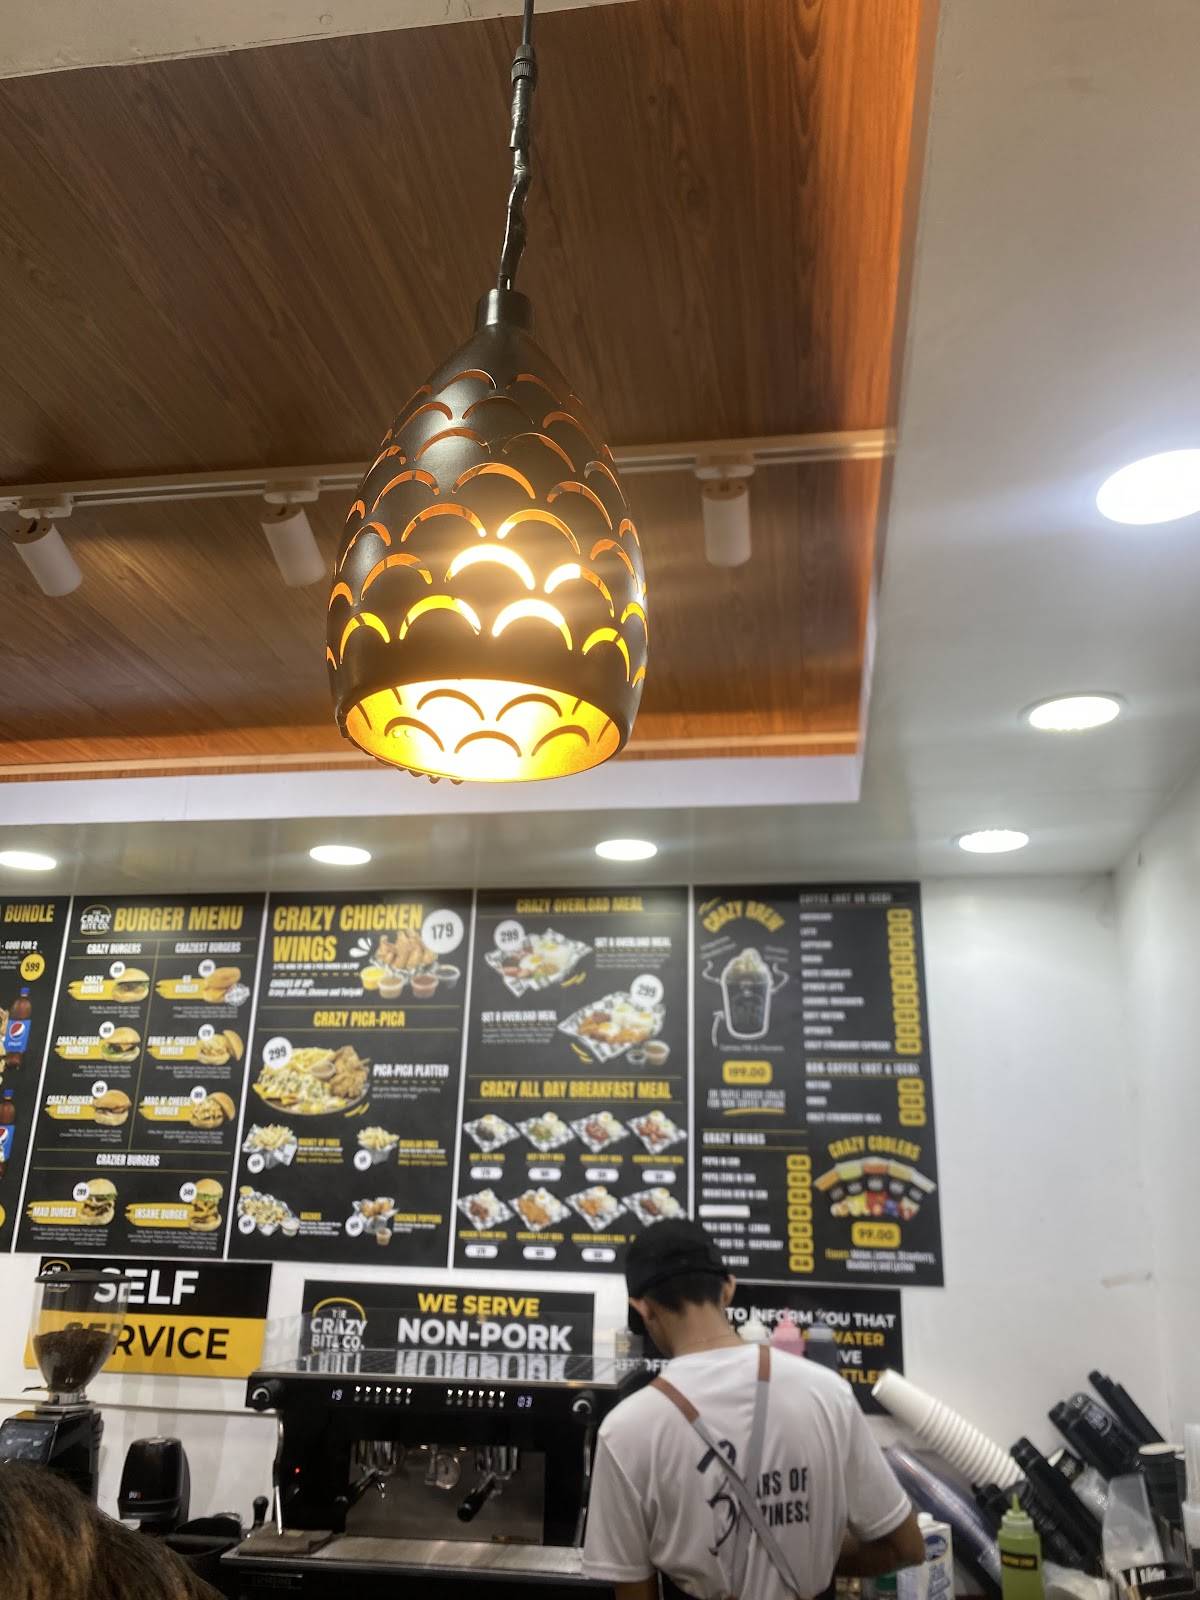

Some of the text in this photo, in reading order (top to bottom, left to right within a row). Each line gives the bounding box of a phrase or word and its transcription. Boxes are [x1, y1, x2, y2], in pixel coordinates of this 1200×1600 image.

[516, 897, 644, 913] CRAZY OVERLOAD MEAL
[4, 904, 55, 923] BUNDLE
[81, 914, 112, 924] CRAZY
[113, 905, 244, 932] BURGER MENU
[273, 904, 423, 931] CRAZY CHICKEN
[702, 901, 742, 933] CRAZY
[81, 923, 97, 931] BITE
[431, 923, 454, 940] 179
[86, 943, 142, 955] CRAZY BURGERS
[175, 942, 241, 953] CRAZIEST BURGERS
[273, 936, 338, 962] WINGS
[25, 963, 40, 973] 599
[313, 1011, 406, 1027] CRAZY PICA-PICA
[267, 1046, 287, 1061] 299
[373, 1064, 449, 1078] PICA-PICA PLATTER
[728, 1066, 766, 1078] 199.00
[480, 1080, 672, 1099] CRAZY ALL DAY BREAKFAST MEAL
[703, 1132, 731, 1144] CRAZY
[828, 1135, 922, 1162] CRAZY COOLERS
[96, 1154, 160, 1167] CRAZIER BURGERS
[50, 1207, 77, 1217] BURGER
[160, 1209, 188, 1220] BURGER
[858, 1228, 895, 1240] 99.00
[94, 1267, 199, 1305] SELF
[418, 1293, 540, 1318] WE SERVE
[726, 1307, 747, 1320] TO
[853, 1312, 896, 1328] THAT
[311, 1318, 367, 1336] CRAZY
[398, 1317, 573, 1351] NON-PORK
[342, 1335, 365, 1350] CO.
[789, 1466, 808, 1492] OF
